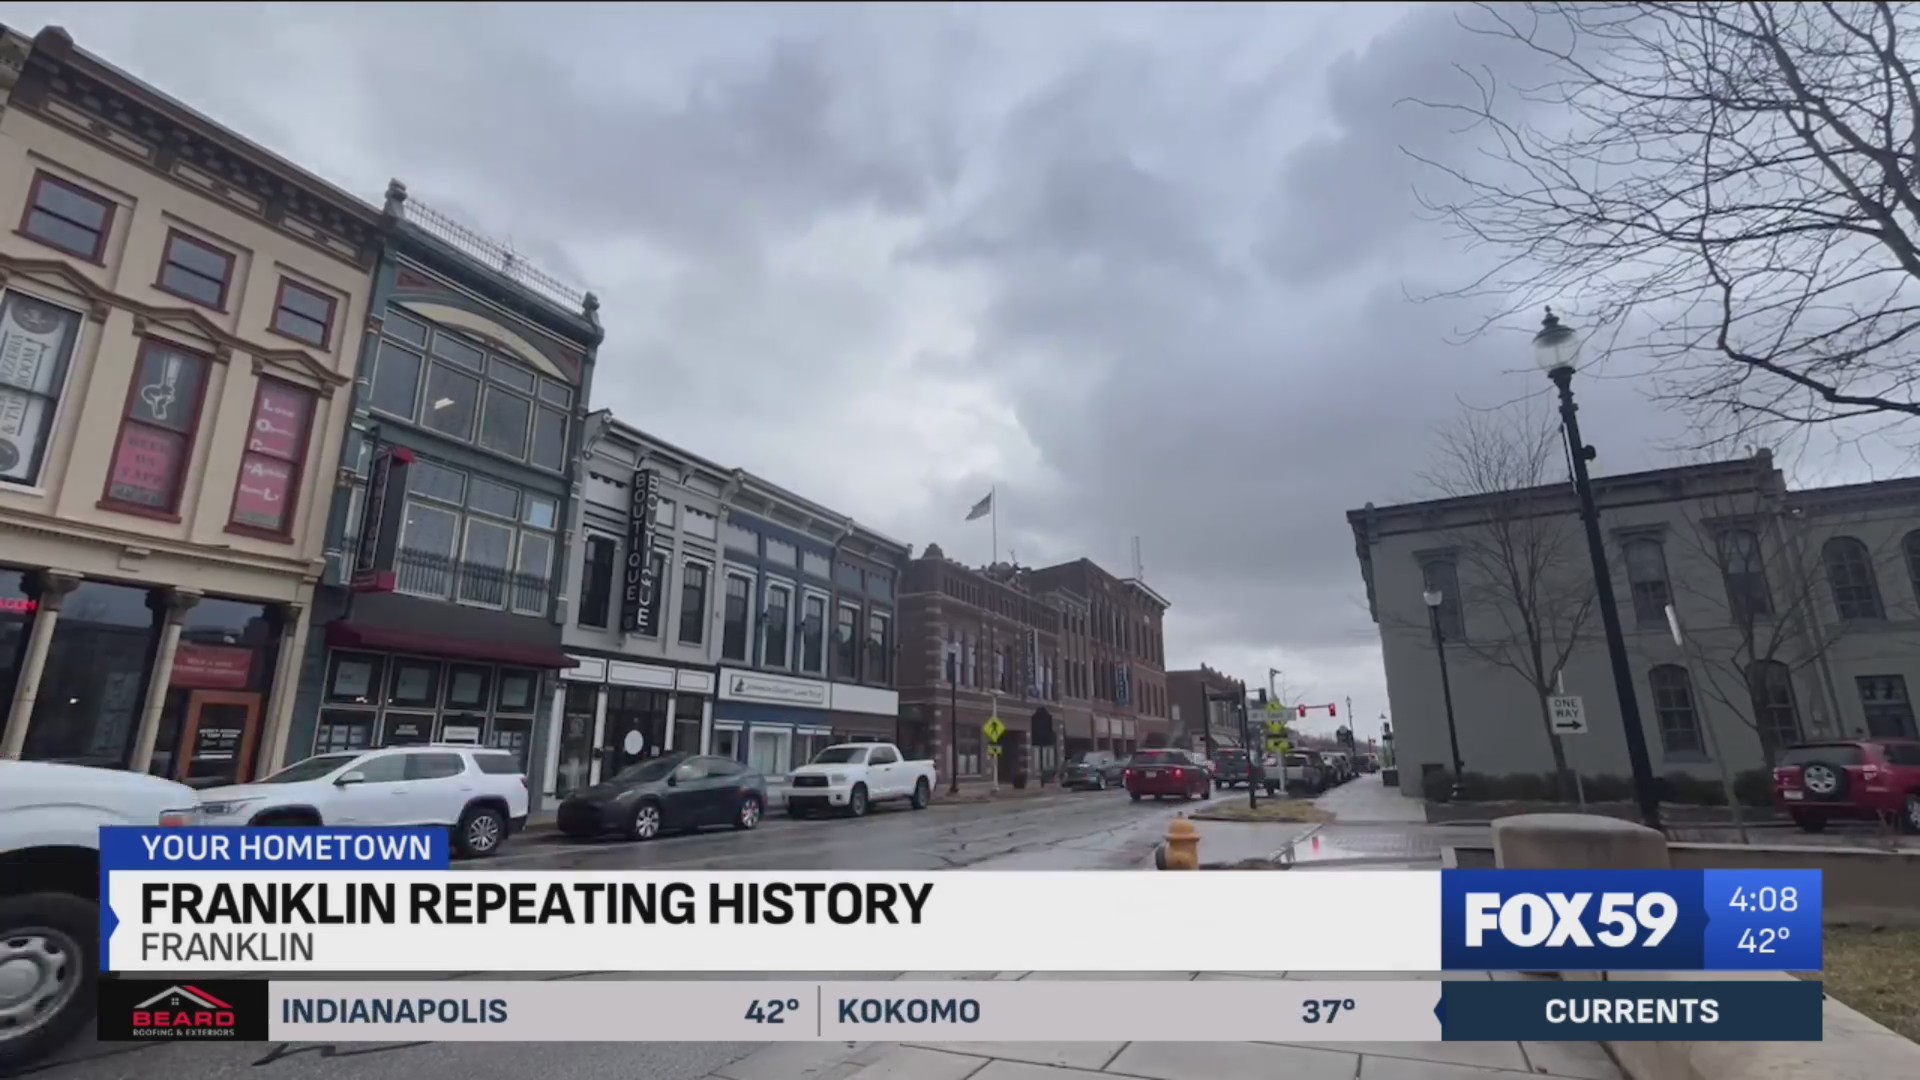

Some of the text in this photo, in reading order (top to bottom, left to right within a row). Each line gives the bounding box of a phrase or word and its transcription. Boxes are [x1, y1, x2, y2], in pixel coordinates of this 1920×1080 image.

[626, 473, 646, 602] BOUTIQUE
[636, 475, 660, 626] BOUTIQUE
[1554, 698, 1578, 709] ONE
[1556, 708, 1580, 718] WAY
